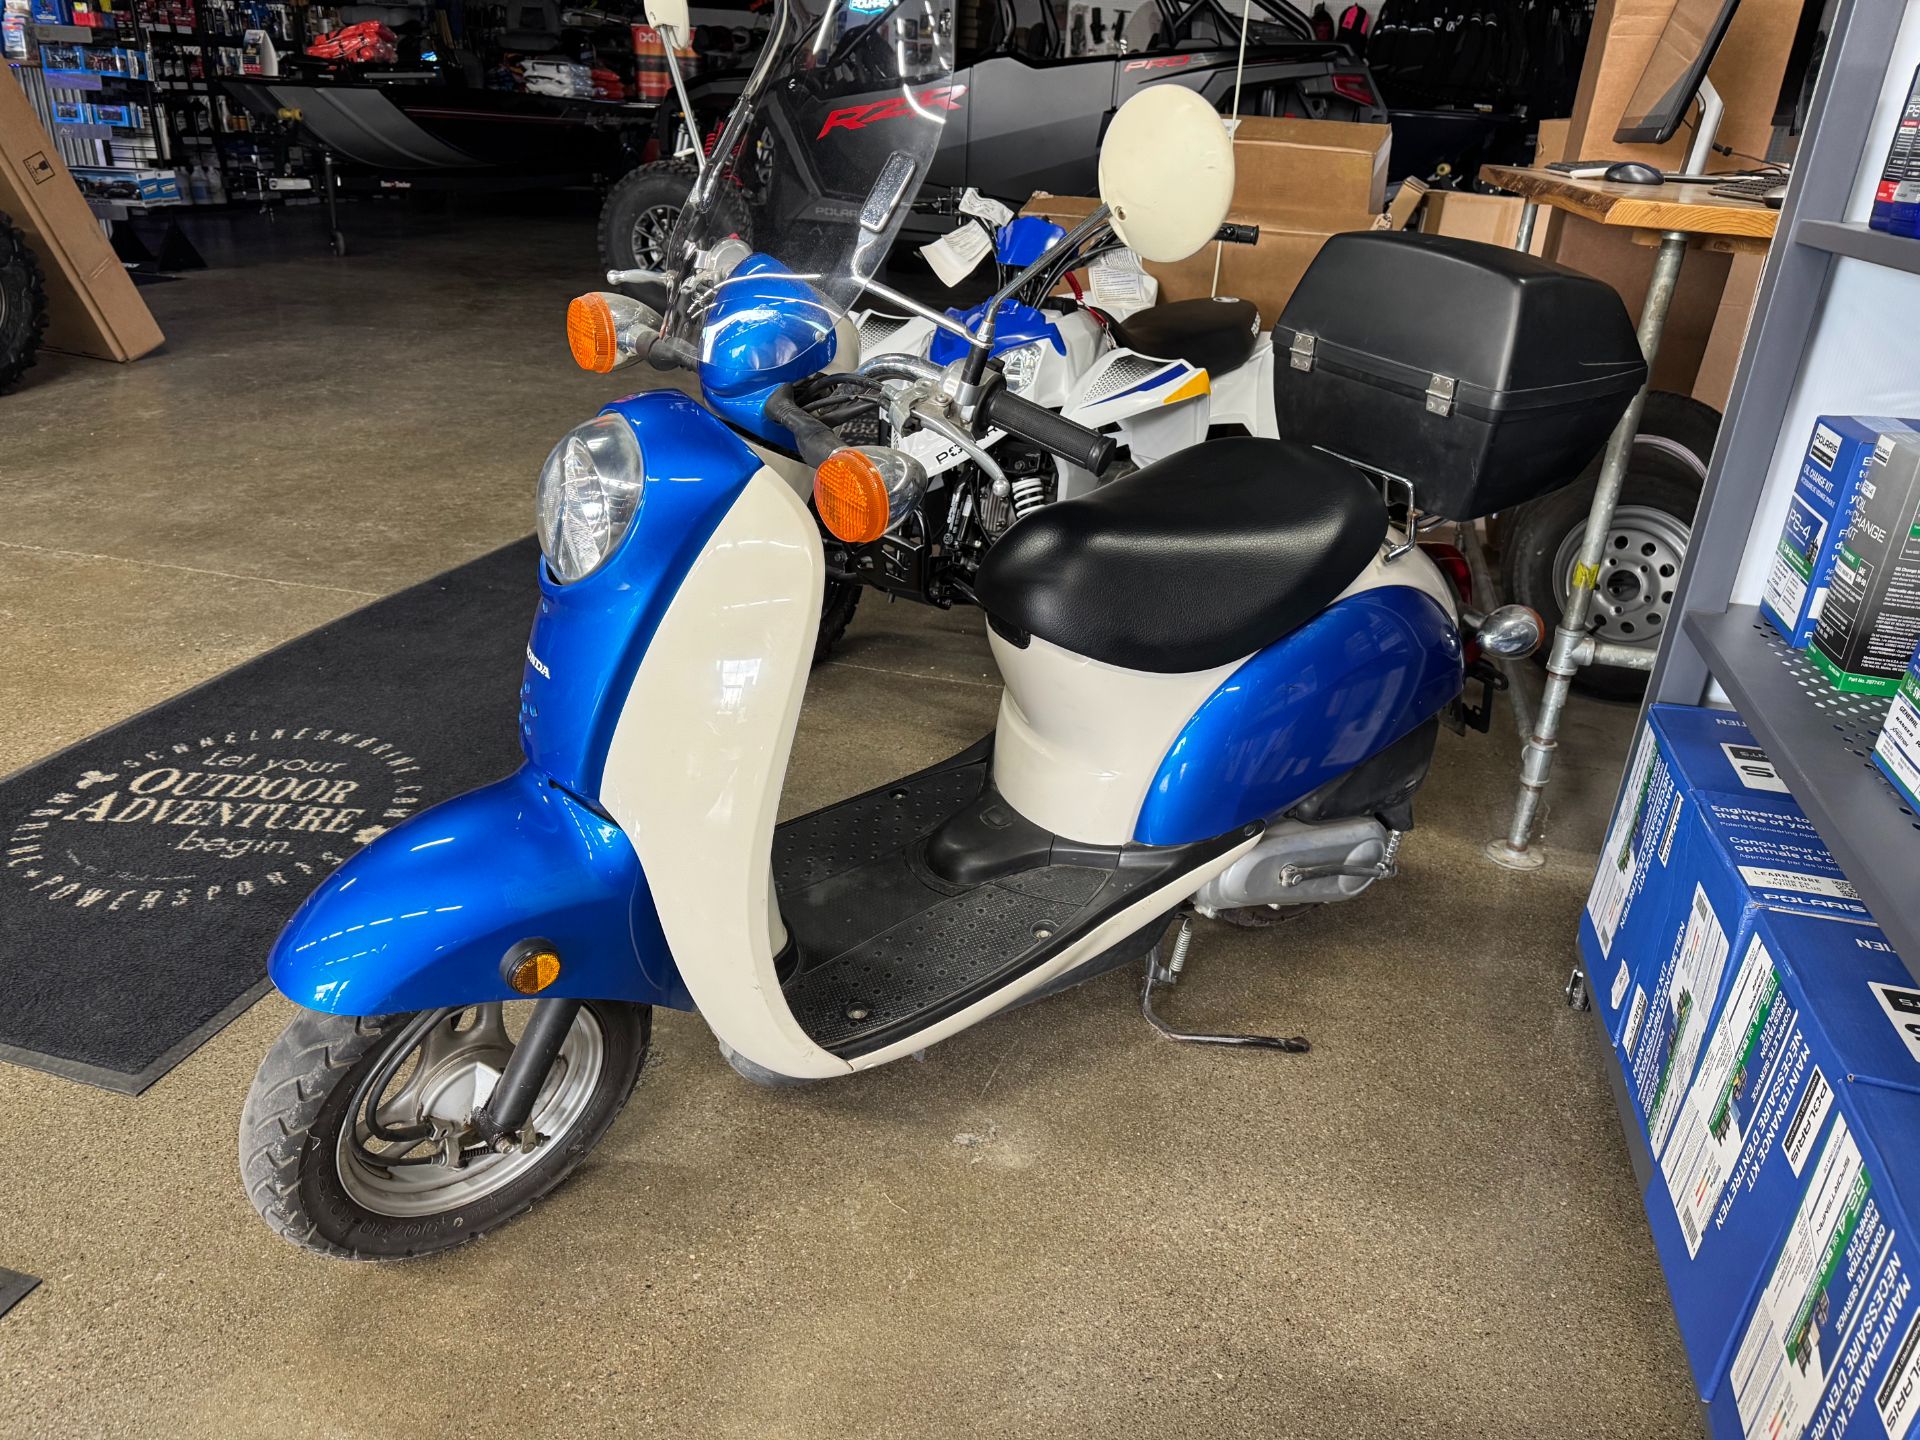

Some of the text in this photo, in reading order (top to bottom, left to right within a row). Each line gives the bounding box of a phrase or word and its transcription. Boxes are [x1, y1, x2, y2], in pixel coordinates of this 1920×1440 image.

[817, 85, 968, 140] RZR
[1814, 432, 1837, 455] POLARIS
[1785, 507, 1813, 541] PS-4
[1850, 506, 1886, 546] CHANGE
[526, 642, 550, 679] ONDA
[129, 767, 359, 804] OUTDOOR
[202, 750, 348, 774] Let your
[62, 790, 365, 834] ADVENTURE
[1637, 778, 1674, 894] MAINTENANCE KIT
[1710, 804, 1791, 820] Engineered
[1714, 812, 1740, 820] the
[1741, 814, 1767, 823] life
[1787, 822, 1816, 831] you
[174, 831, 295, 859] begin.
[1728, 835, 1777, 848] Conçu
[1779, 844, 1813, 853] pour
[1733, 844, 1800, 858] optimale
[1802, 853, 1822, 861] de
[1753, 870, 1821, 883] LEARN MORE
[1761, 892, 1867, 913] POLARIS
[1659, 919, 1684, 1010] D'ENTRETIEN
[1632, 959, 1667, 1078] MAINTENANCE KIT
[1759, 996, 1787, 1060] PRESTATION
[1750, 1006, 1792, 1103] COMPLETE SERVICE
[1756, 1027, 1804, 1136] NÉCESSAIRE
[1755, 1042, 1810, 1166] MAINTENANCE
[1790, 1081, 1827, 1166] POLARIS
[1714, 1128, 1760, 1231] D'ENTRETIEN
[1744, 1158, 1760, 1192] KIT
[1814, 1153, 1851, 1238] SPORTSMAN
[1836, 1173, 1866, 1238] PS-4
[1845, 1206, 1879, 1283] PRESTATION
[1834, 1221, 1885, 1335] COMPLETE SERVICE
[1844, 1248, 1902, 1380] NÉCESSAIRE
[1842, 1267, 1911, 1422] MAINTENANCE
